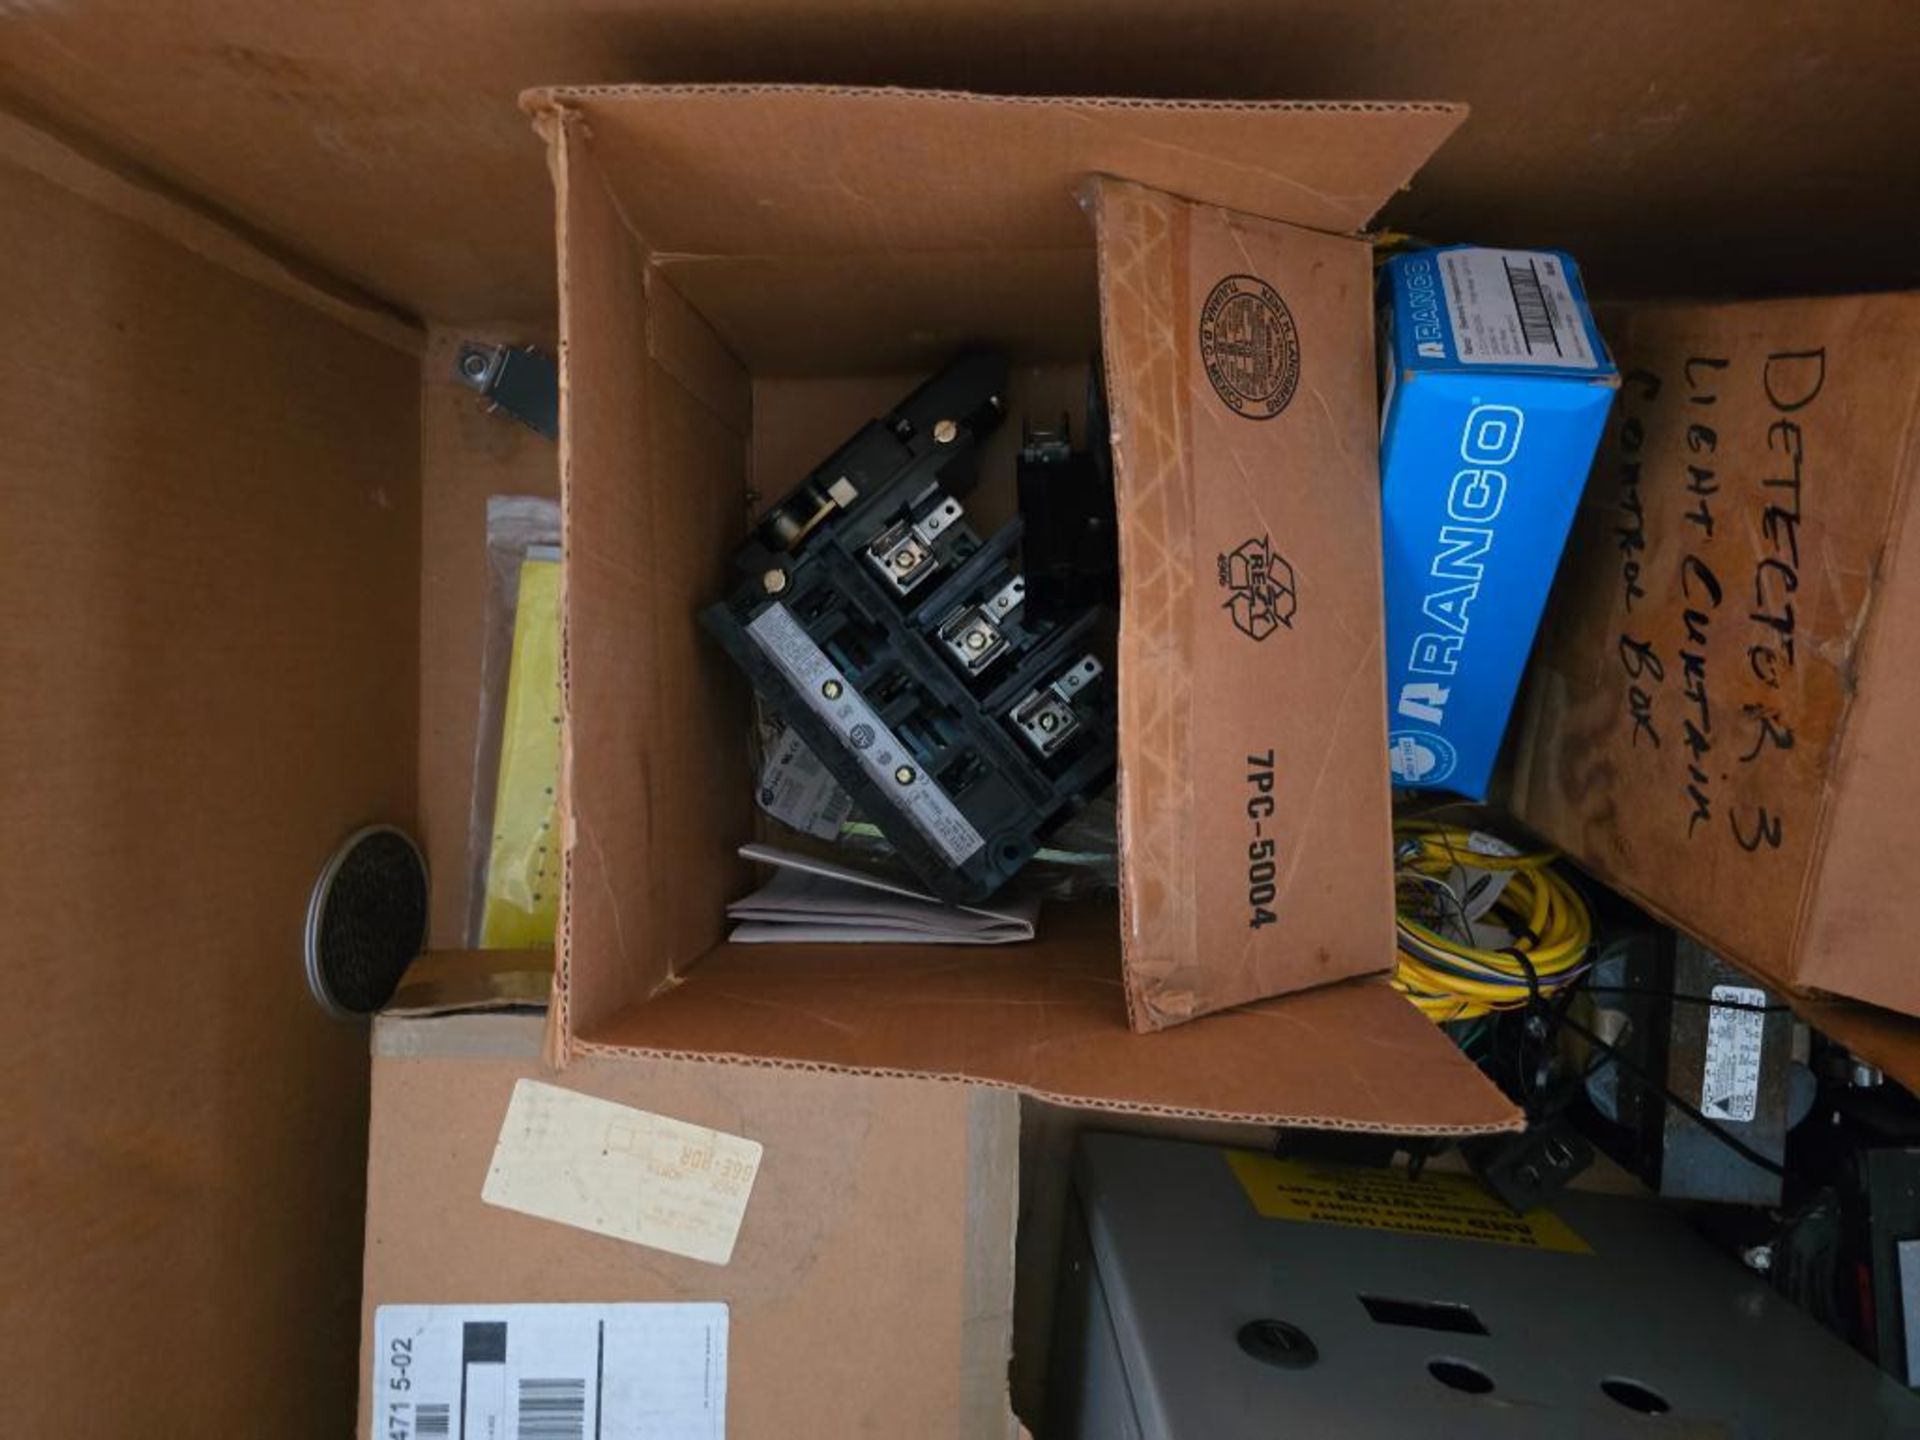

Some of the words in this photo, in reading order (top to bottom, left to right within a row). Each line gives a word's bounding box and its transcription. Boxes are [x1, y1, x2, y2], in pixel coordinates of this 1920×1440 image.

[1246, 749, 1278, 929] 7PC-5004
[1730, 805, 1782, 852] 3
[389, 1336, 413, 1392] 5-02
